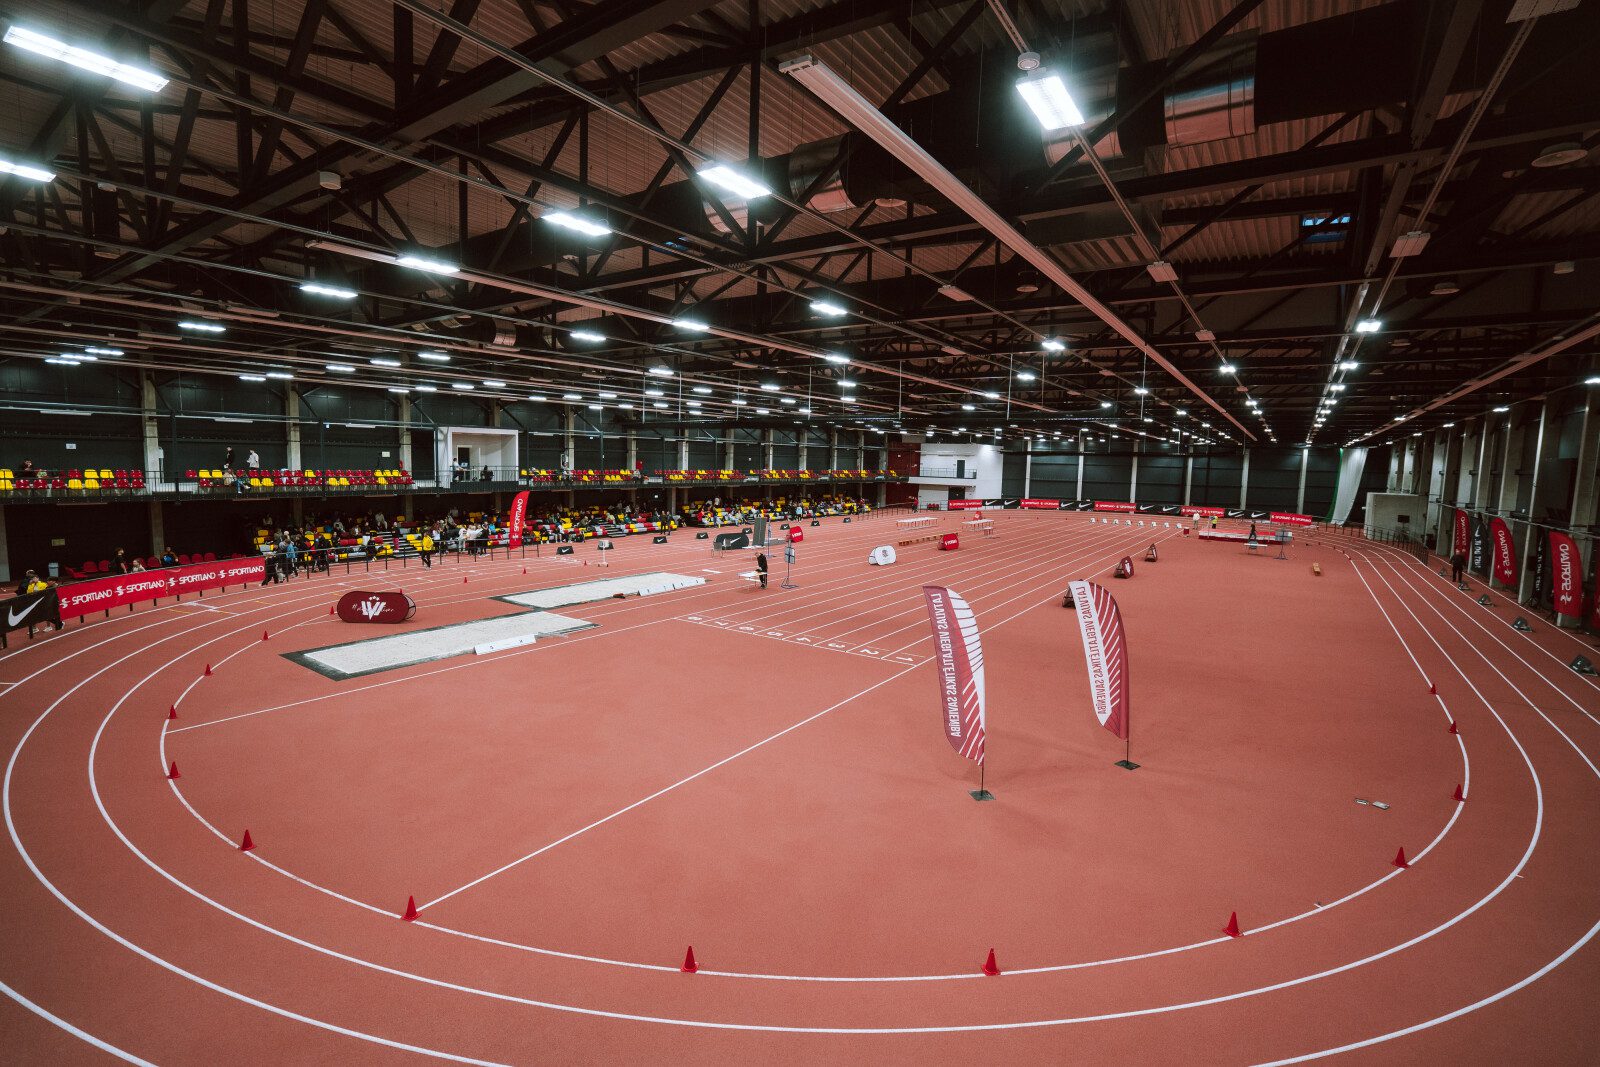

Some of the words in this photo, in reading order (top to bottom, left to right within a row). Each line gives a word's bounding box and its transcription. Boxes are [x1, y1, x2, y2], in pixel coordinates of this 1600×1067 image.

[513, 498, 524, 532] SPORTLAND
[71, 589, 113, 605] SPORTLAND
[126, 579, 165, 593] SPORTLAND
[178, 572, 217, 585] SPORTLAND
[228, 565, 265, 577] SPORTLAND
